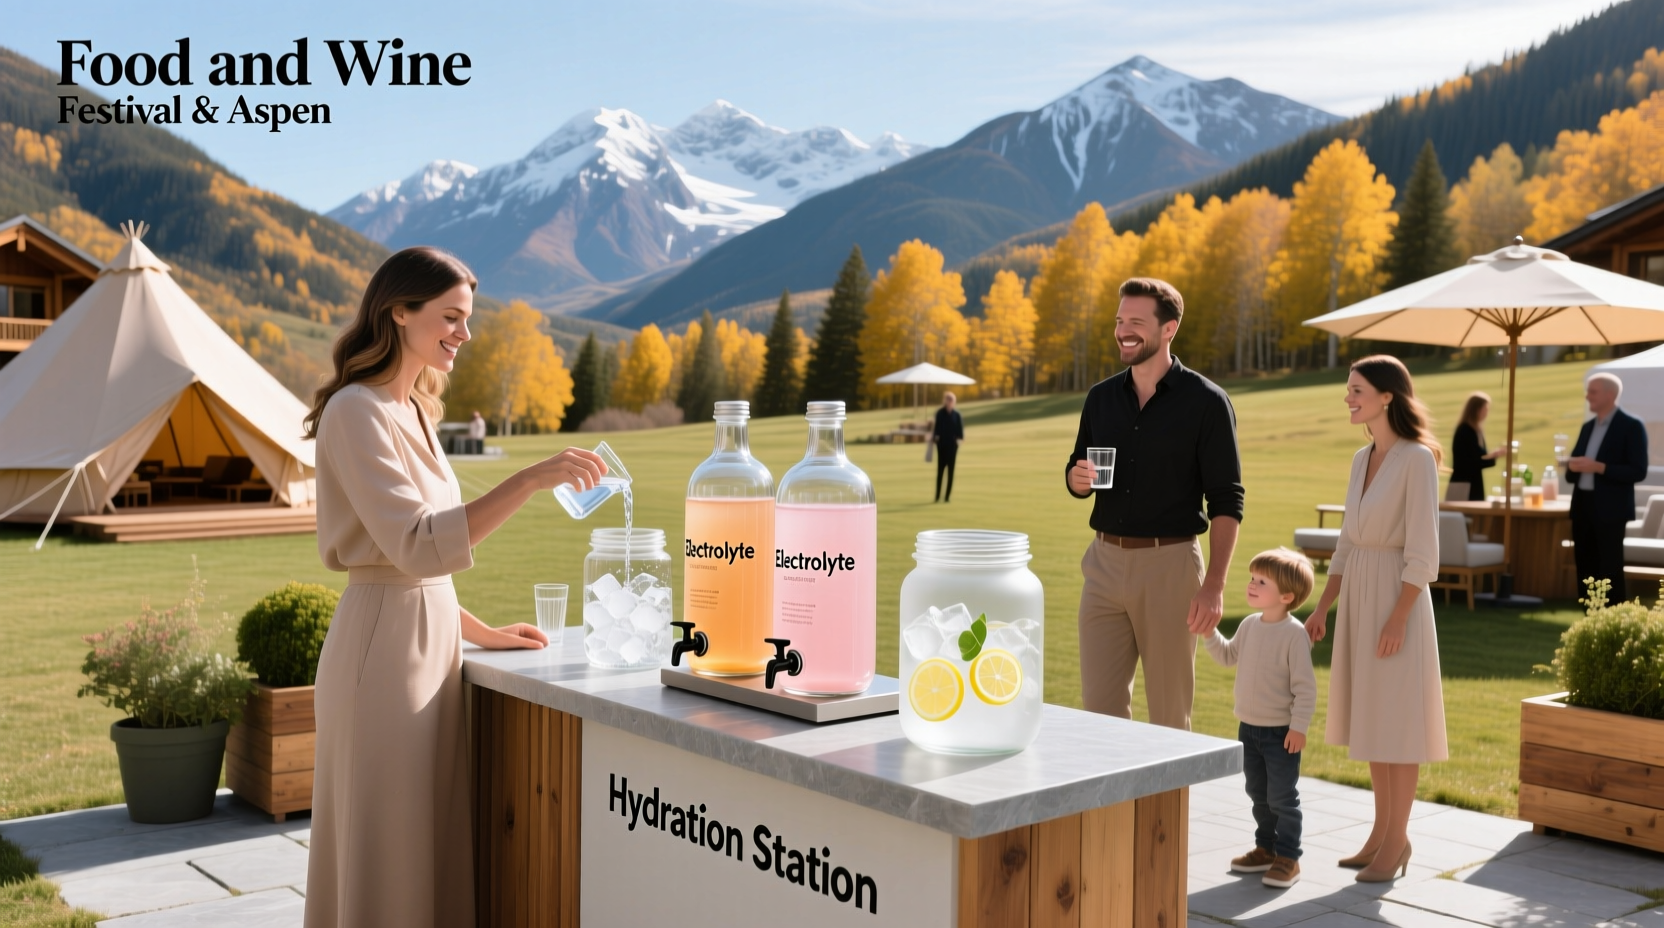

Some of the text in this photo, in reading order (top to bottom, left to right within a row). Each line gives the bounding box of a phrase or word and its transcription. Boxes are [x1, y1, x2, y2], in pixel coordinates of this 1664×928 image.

[775, 549, 855, 577] Electrolyte
[609, 772, 878, 915] Hydration Station
